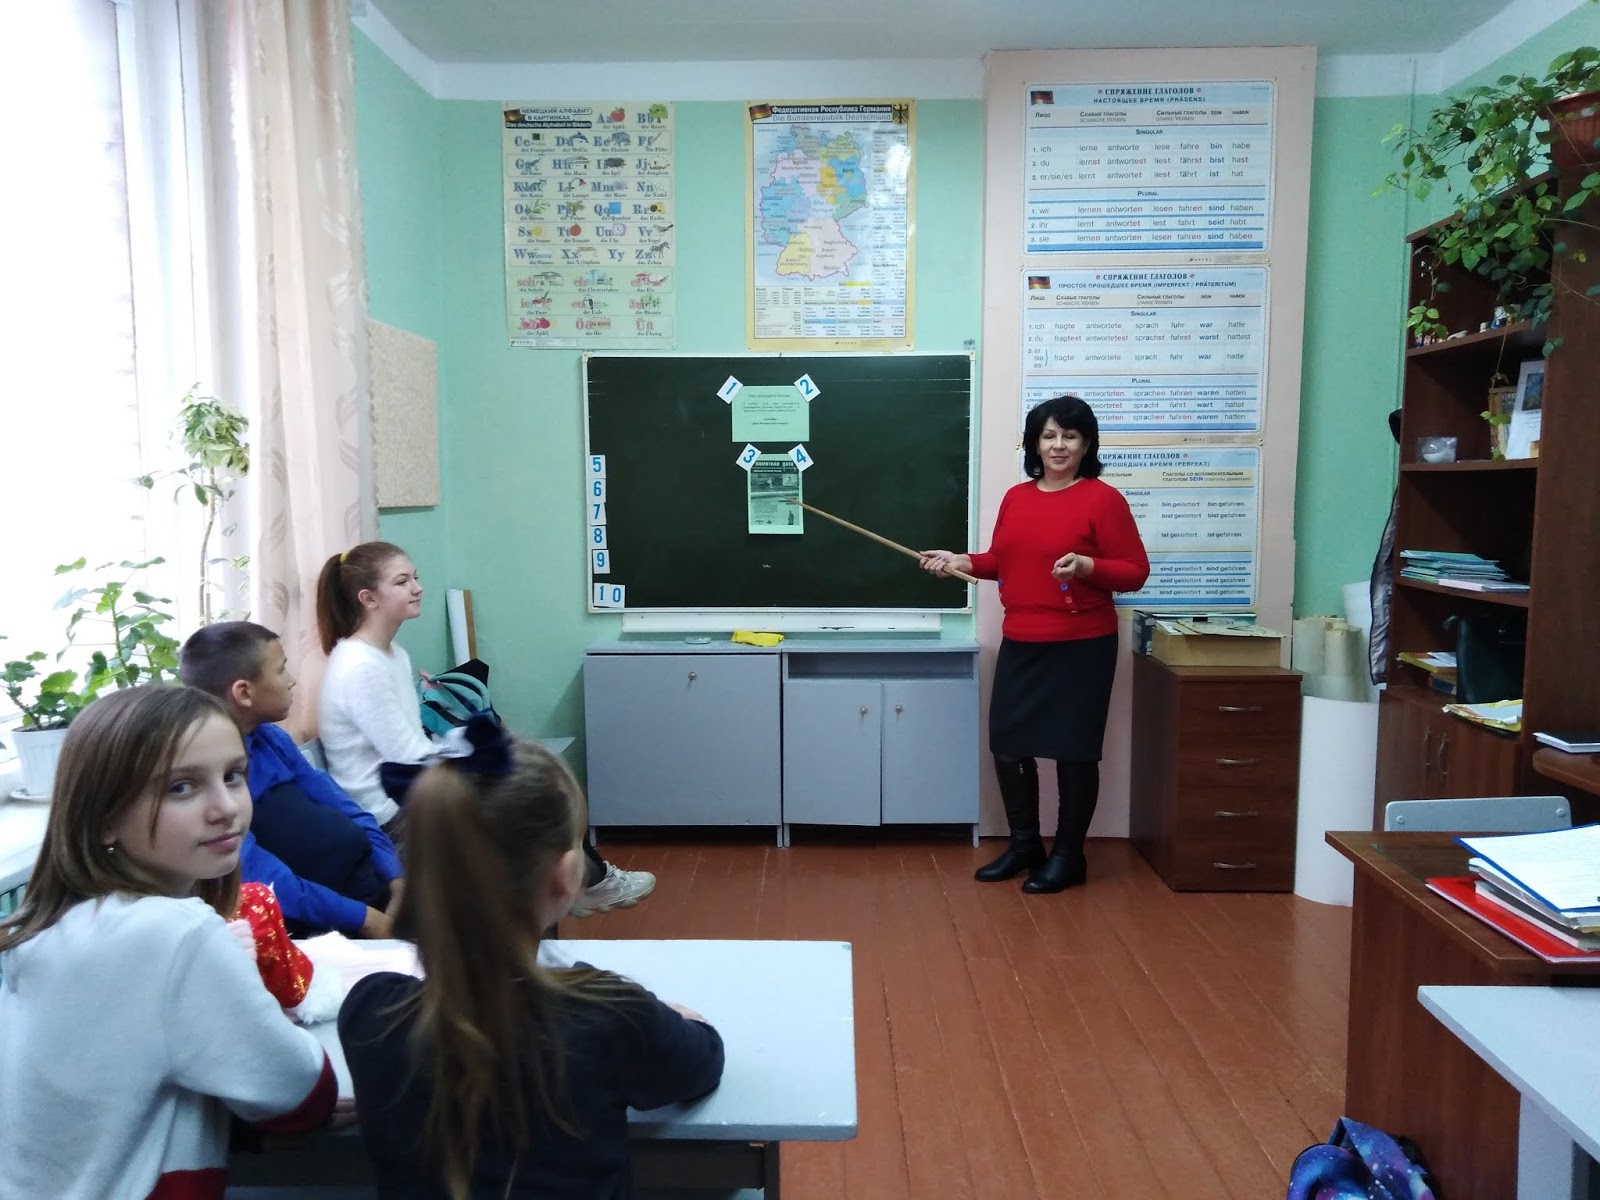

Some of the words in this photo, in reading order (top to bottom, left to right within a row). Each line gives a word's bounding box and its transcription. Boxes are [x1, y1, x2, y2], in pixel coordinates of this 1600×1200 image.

[1167, 95, 1206, 103] (PRÄSENS)
[772, 106, 819, 114] Федеративная
[821, 106, 858, 114] Республика
[787, 114, 843, 122] Bundesrepublik
[608, 249, 625, 262] Yy
[726, 382, 737, 395] 1
[800, 379, 814, 394] 2
[744, 449, 756, 464] 3
[796, 448, 806, 463] 4
[592, 456, 601, 472] 5
[593, 481, 602, 496] 6
[593, 504, 601, 519] 7
[593, 528, 603, 543] 8
[596, 552, 605, 568] 9
